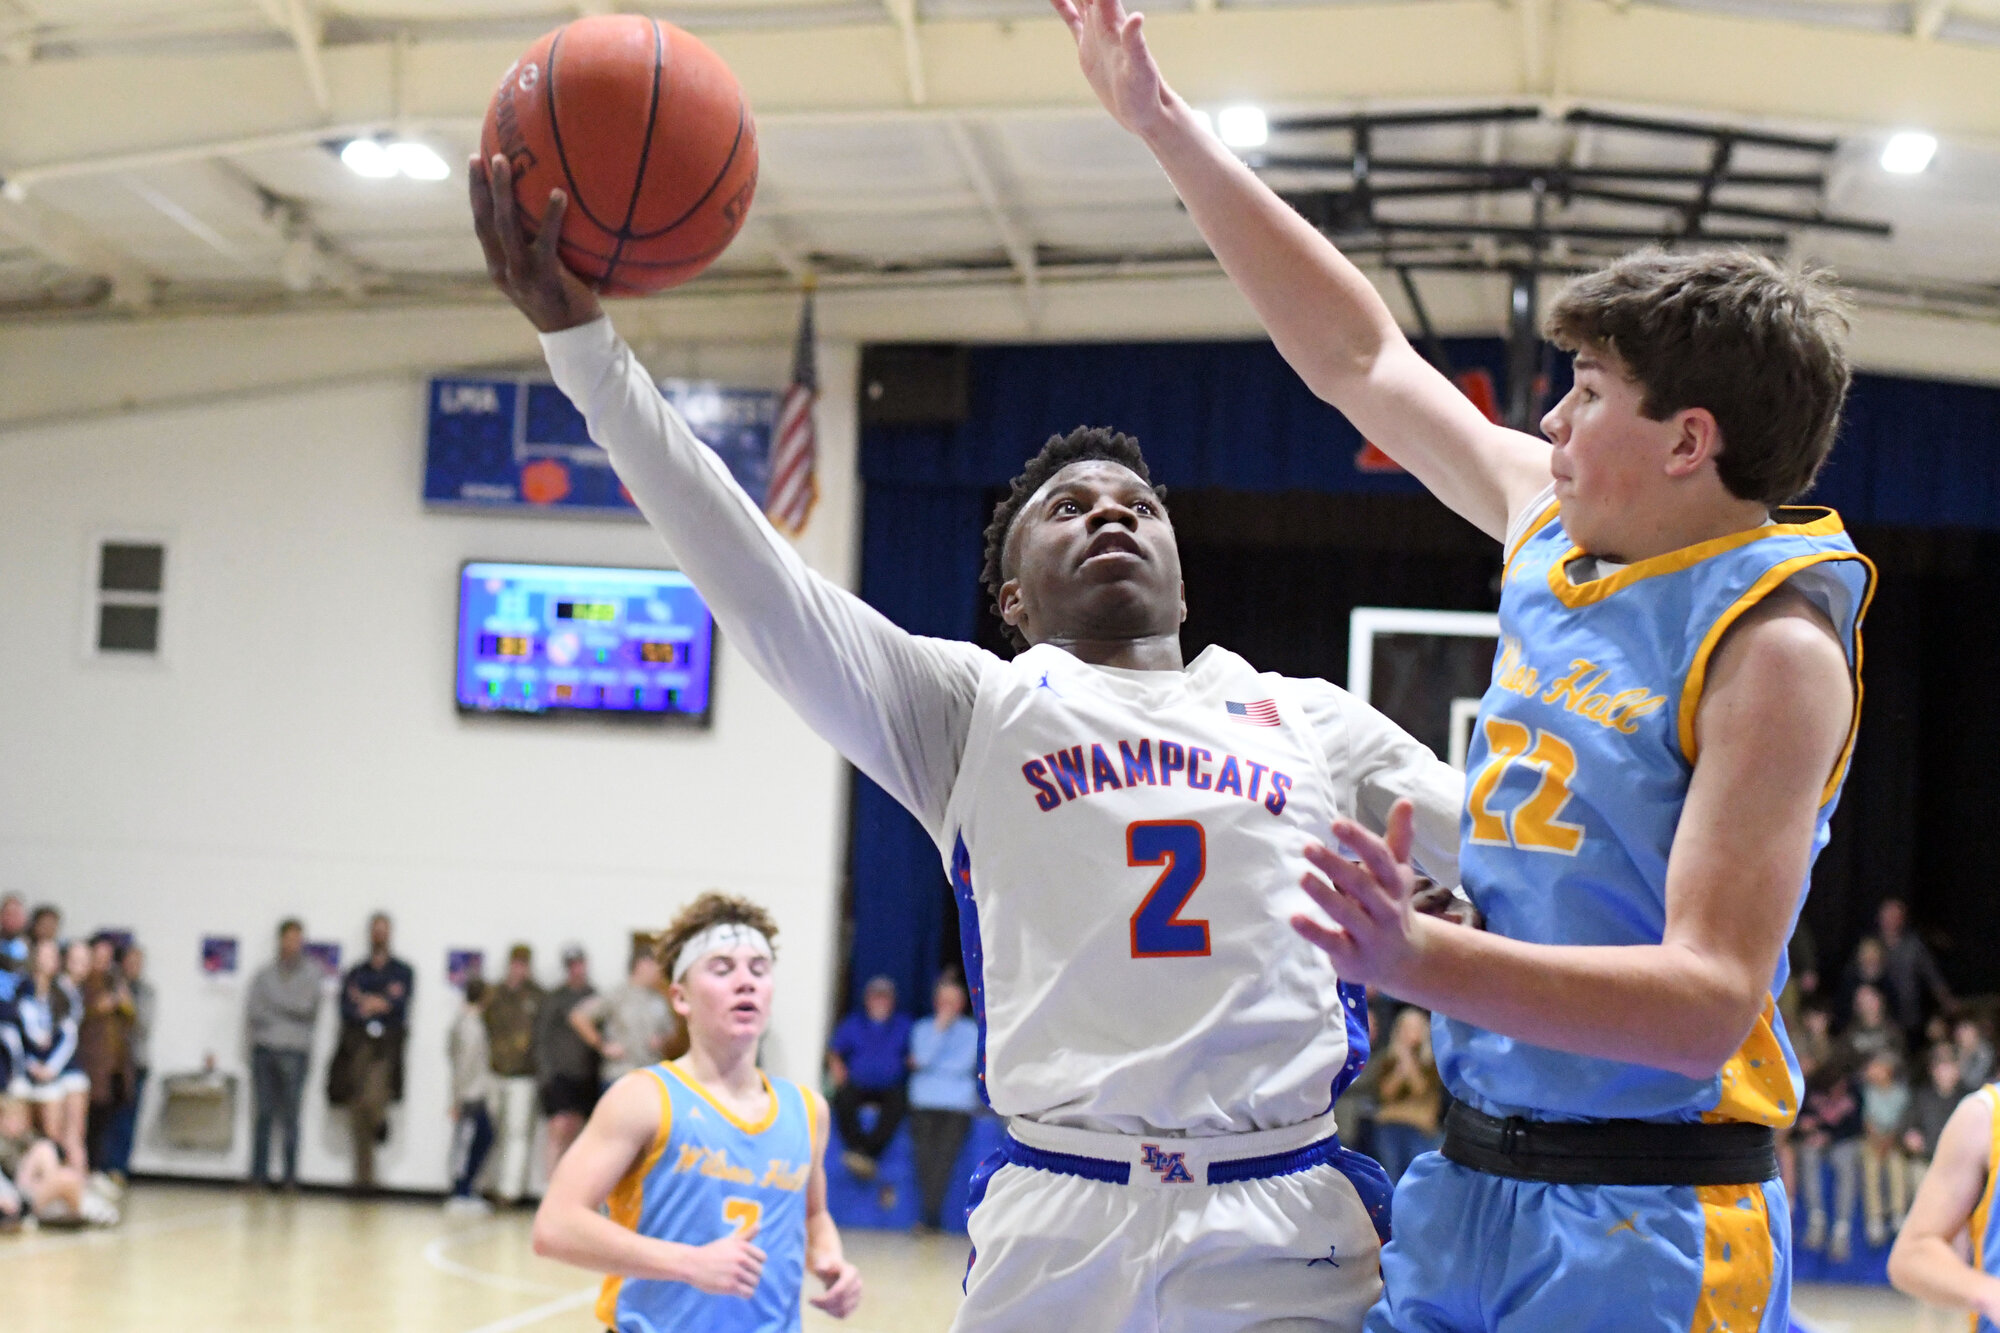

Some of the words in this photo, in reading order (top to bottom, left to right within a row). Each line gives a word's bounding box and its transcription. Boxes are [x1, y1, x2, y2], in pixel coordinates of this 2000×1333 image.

[439, 386, 499, 413] LMA
[1542, 659, 1668, 734] Hall
[1021, 738, 1293, 816] SWAMPCATS
[1466, 714, 1586, 857] 22
[1126, 819, 1211, 959] 2
